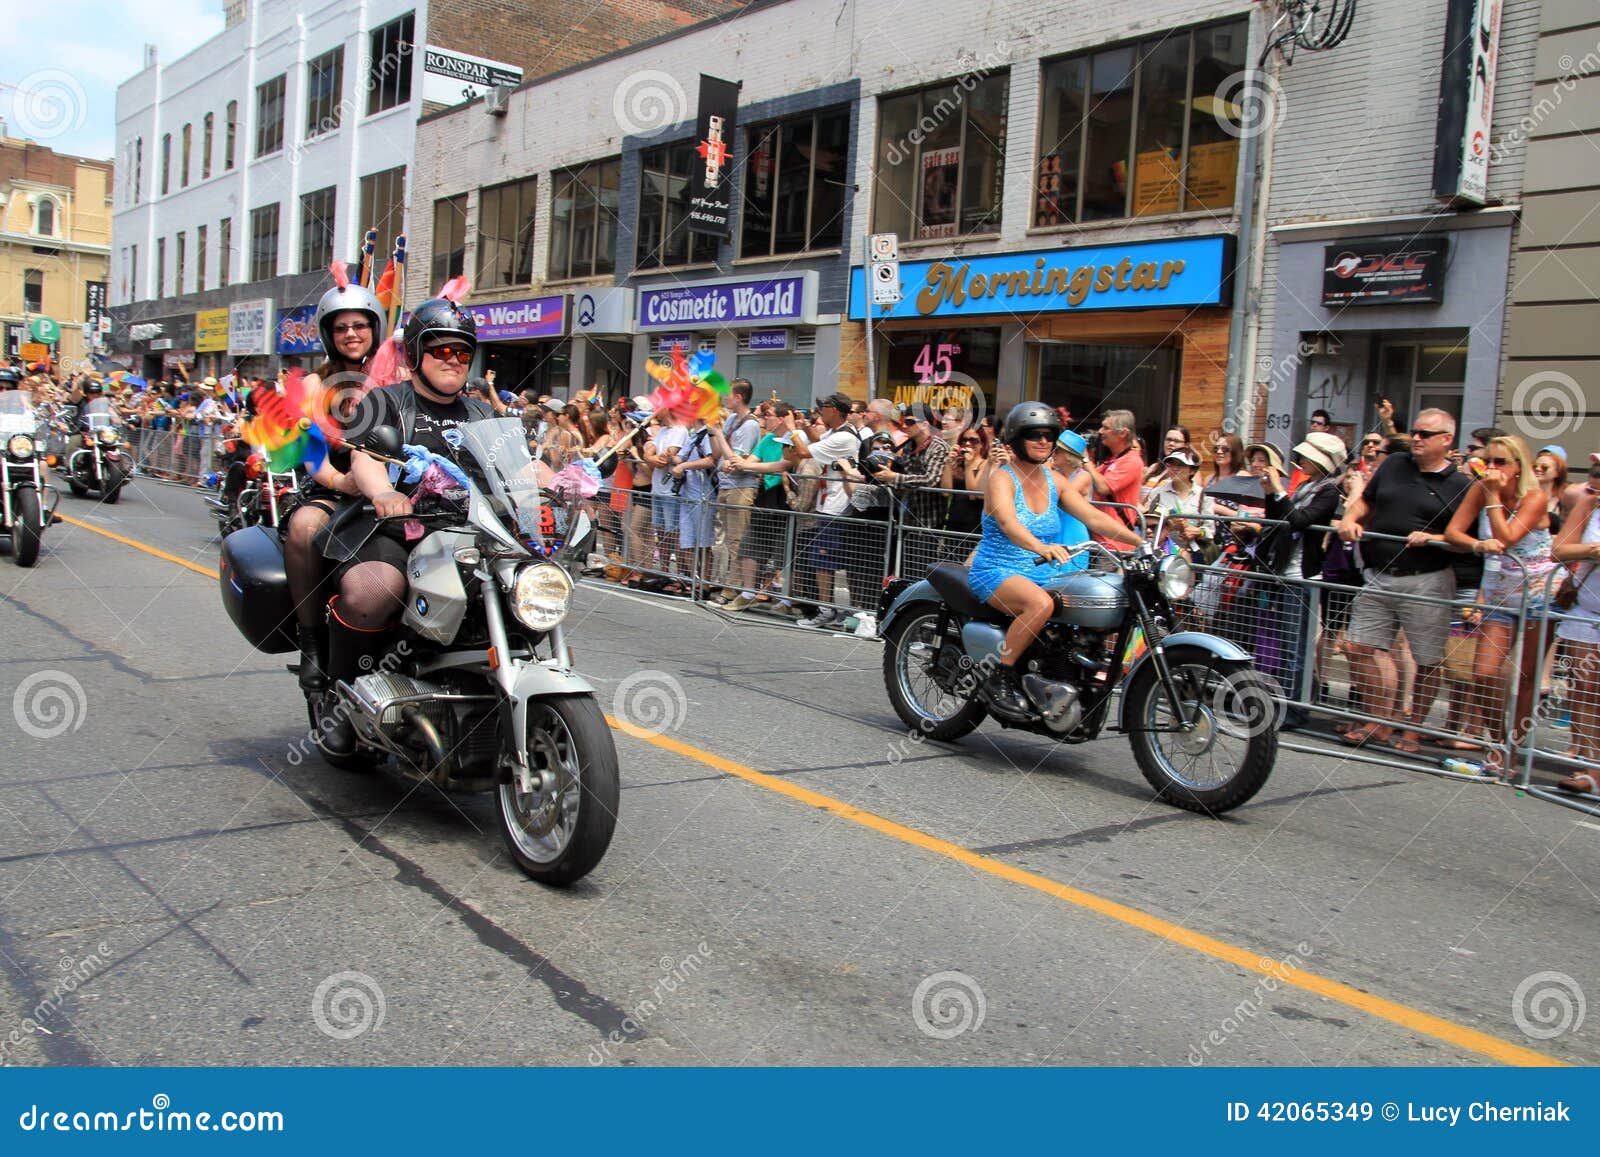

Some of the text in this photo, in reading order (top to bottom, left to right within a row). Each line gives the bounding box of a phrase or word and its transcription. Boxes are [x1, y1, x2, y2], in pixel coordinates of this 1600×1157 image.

[426, 52, 489, 79] RONSPAR
[648, 281, 796, 323] Cosmetic World
[916, 256, 1186, 315] Morningstar
[488, 303, 543, 326] World
[894, 385, 975, 411] ANNIVERSARY
[486, 426, 528, 470] TORONTO
